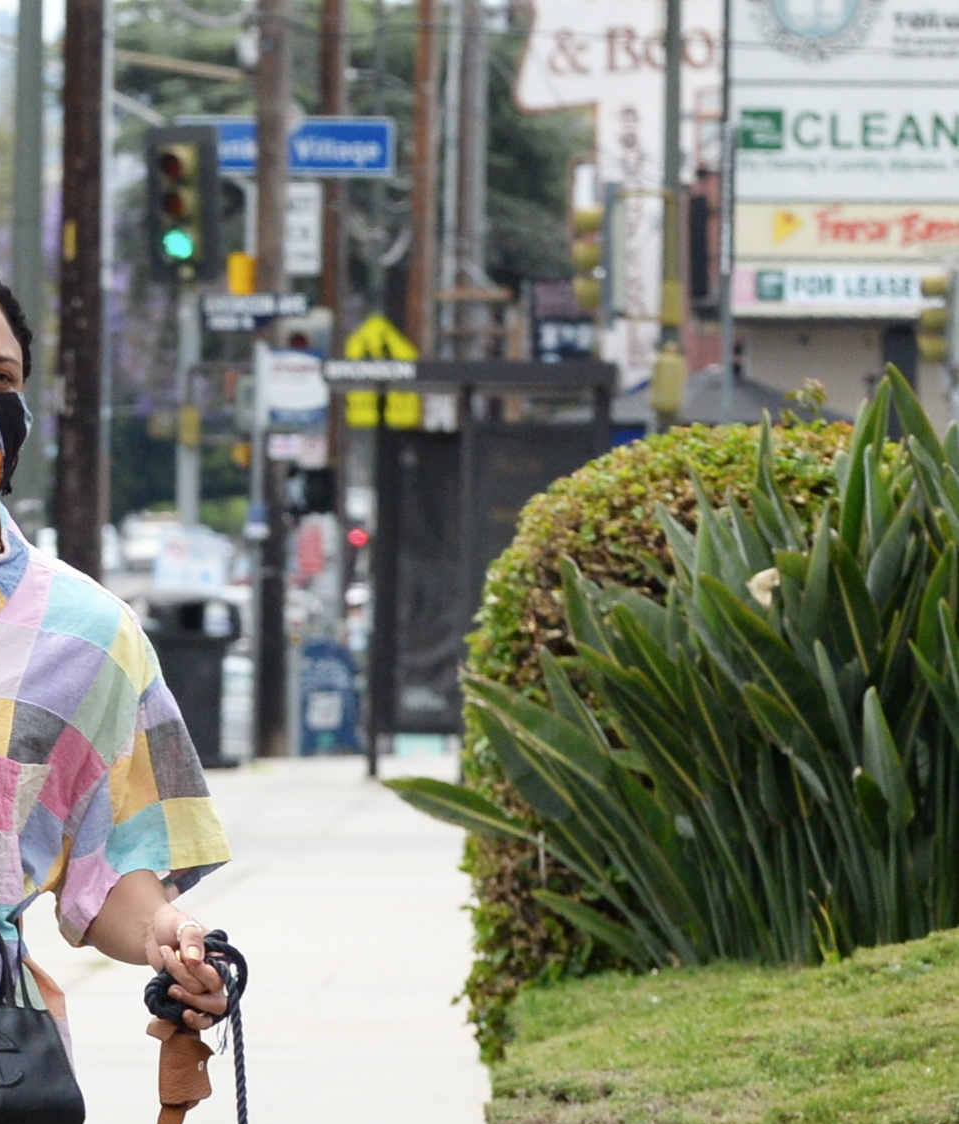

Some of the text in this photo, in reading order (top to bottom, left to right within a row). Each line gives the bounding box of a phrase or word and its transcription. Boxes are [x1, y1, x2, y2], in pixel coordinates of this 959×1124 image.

[793, 111, 959, 149] CLEAN
[294, 136, 382, 167] Village
[793, 275, 912, 297] FOR LEASE
